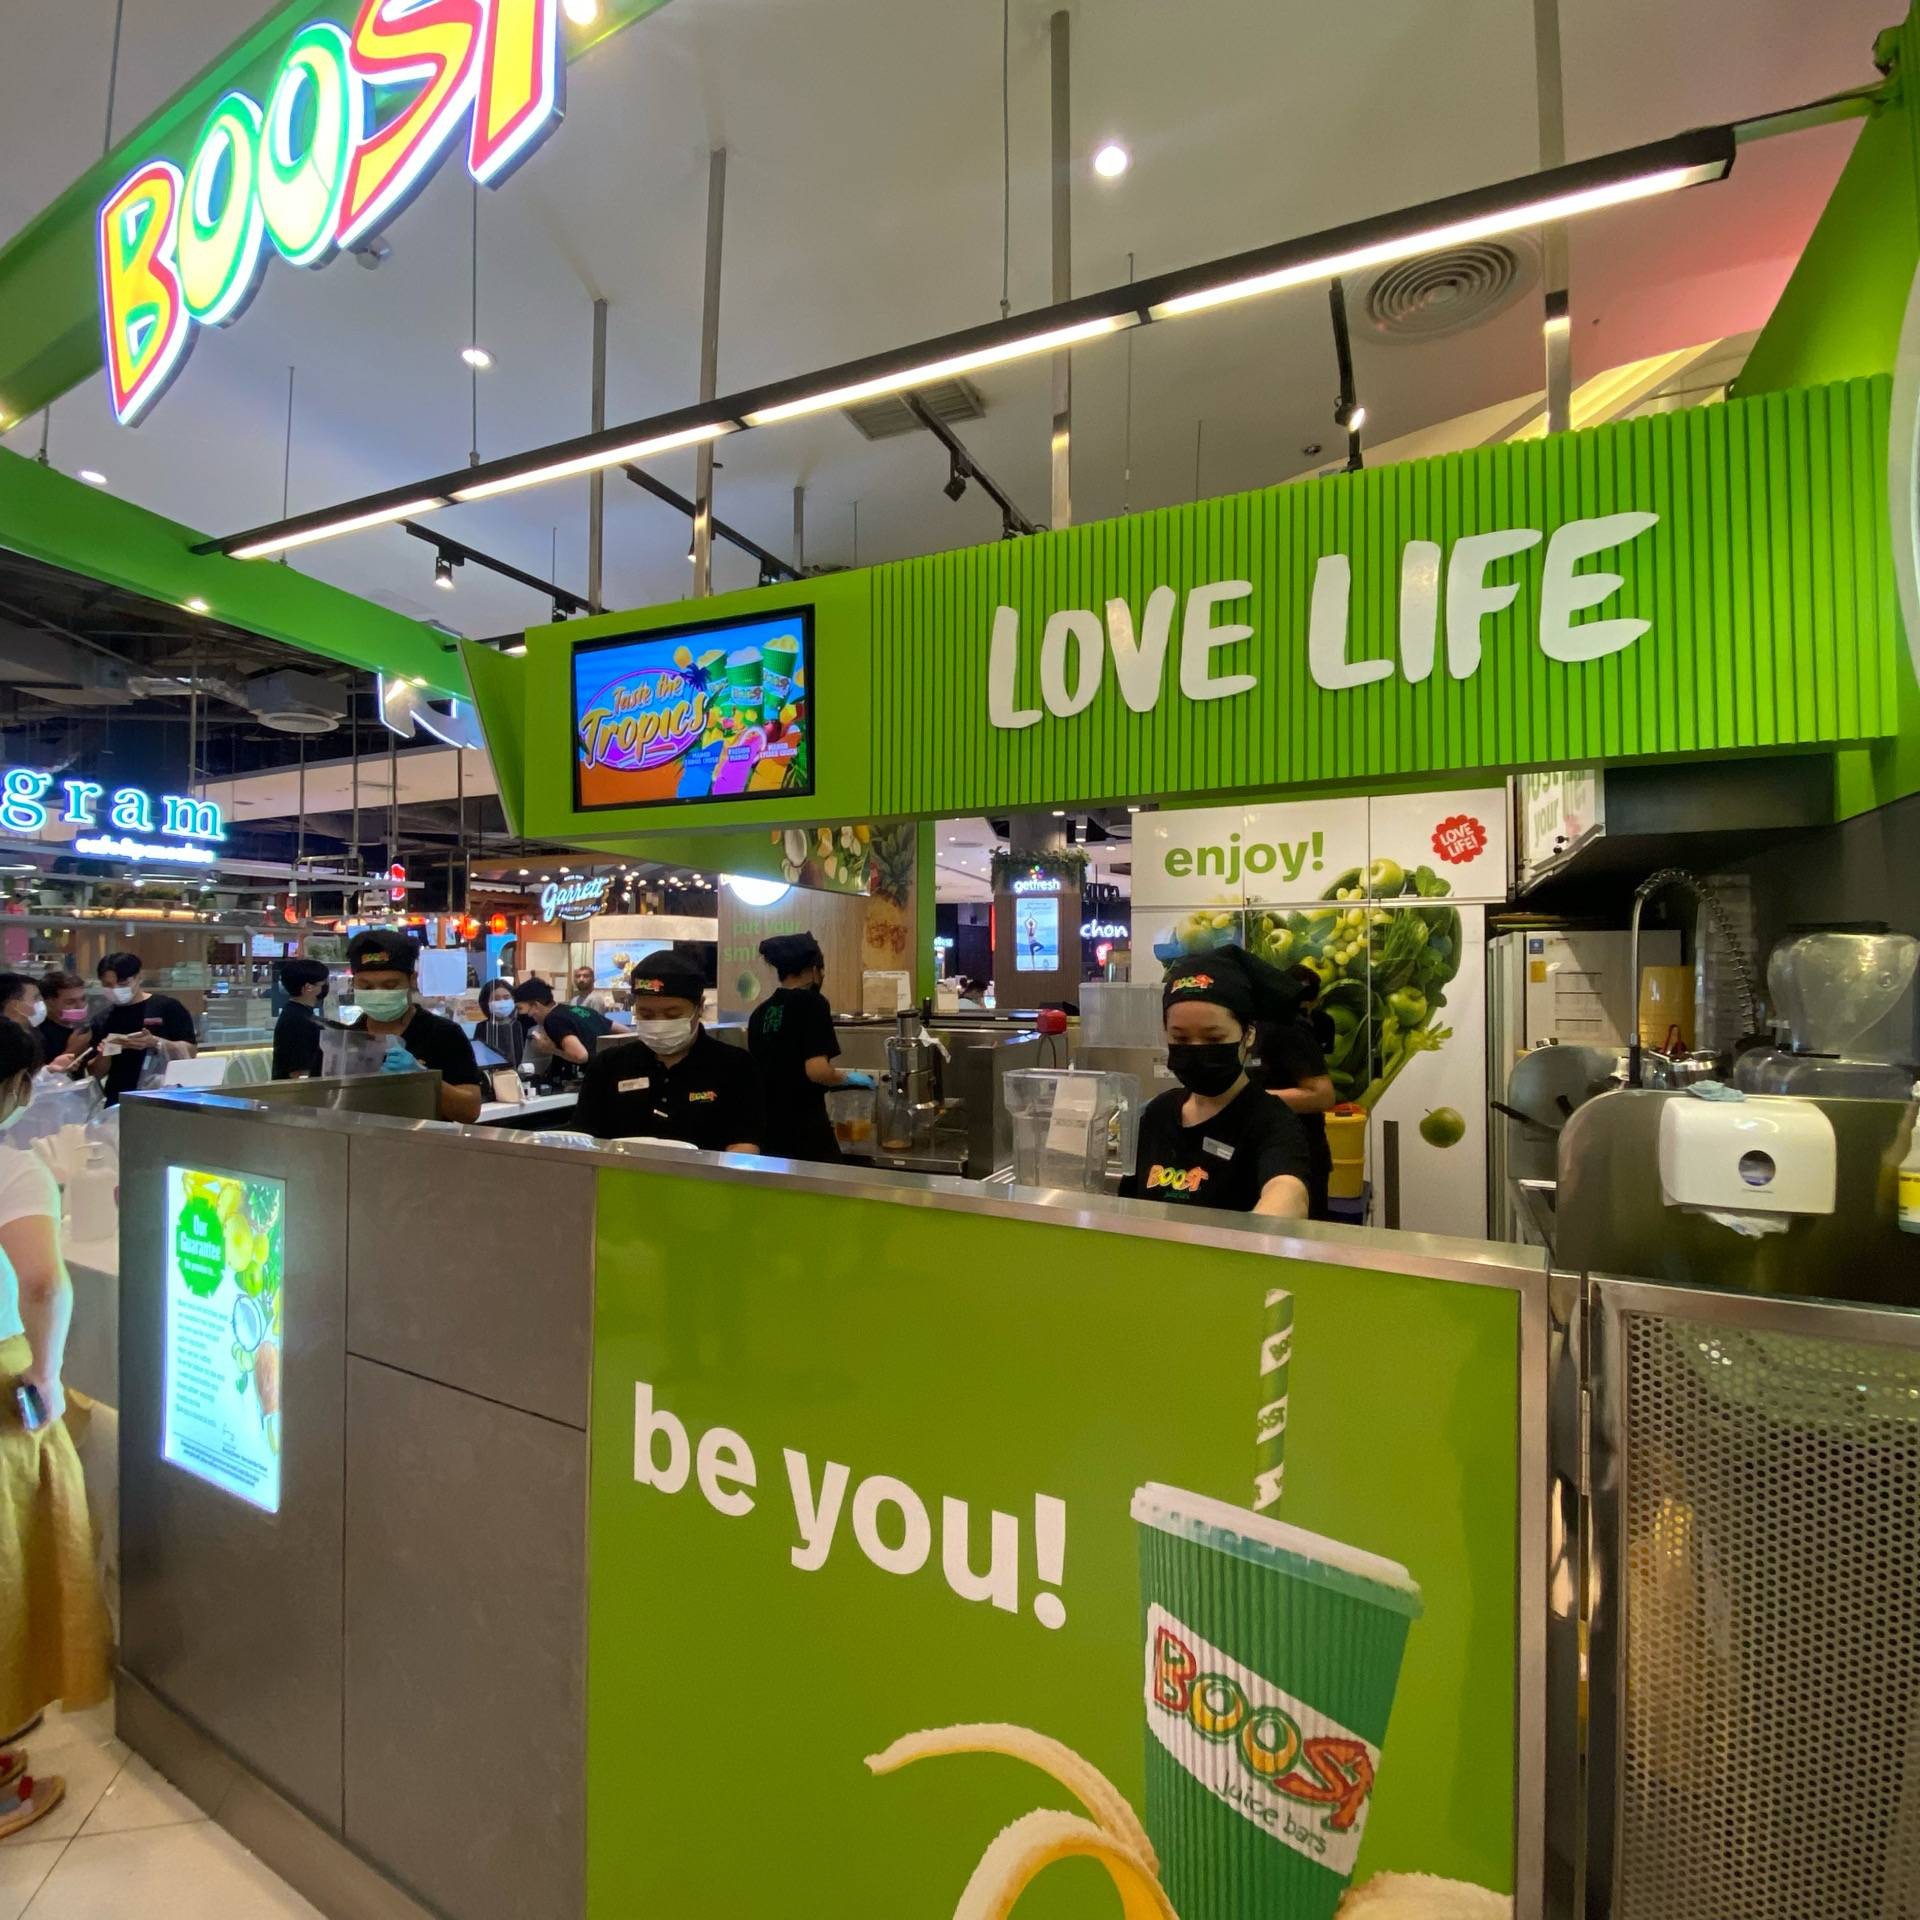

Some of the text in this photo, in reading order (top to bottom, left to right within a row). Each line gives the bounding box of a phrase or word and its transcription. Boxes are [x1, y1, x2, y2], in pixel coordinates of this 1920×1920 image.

[988, 511, 1660, 730] LOVE LIFE
[613, 683, 651, 714] Taste
[656, 671, 685, 699] the
[579, 689, 707, 769] Tropics
[0, 768, 226, 842] gram
[1440, 822, 1474, 846] LOVE
[1447, 834, 1480, 857] LIFE!
[1164, 831, 1324, 884] enjoy!
[541, 877, 609, 922] Garrett
[1014, 878, 1061, 894] getfresh
[1080, 918, 1129, 937] chon
[1146, 1164, 1209, 1193] BOOST
[633, 1380, 1067, 1630] be you!
[1153, 1625, 1376, 1833] BOOST
[1286, 1810, 1327, 1854] bars
